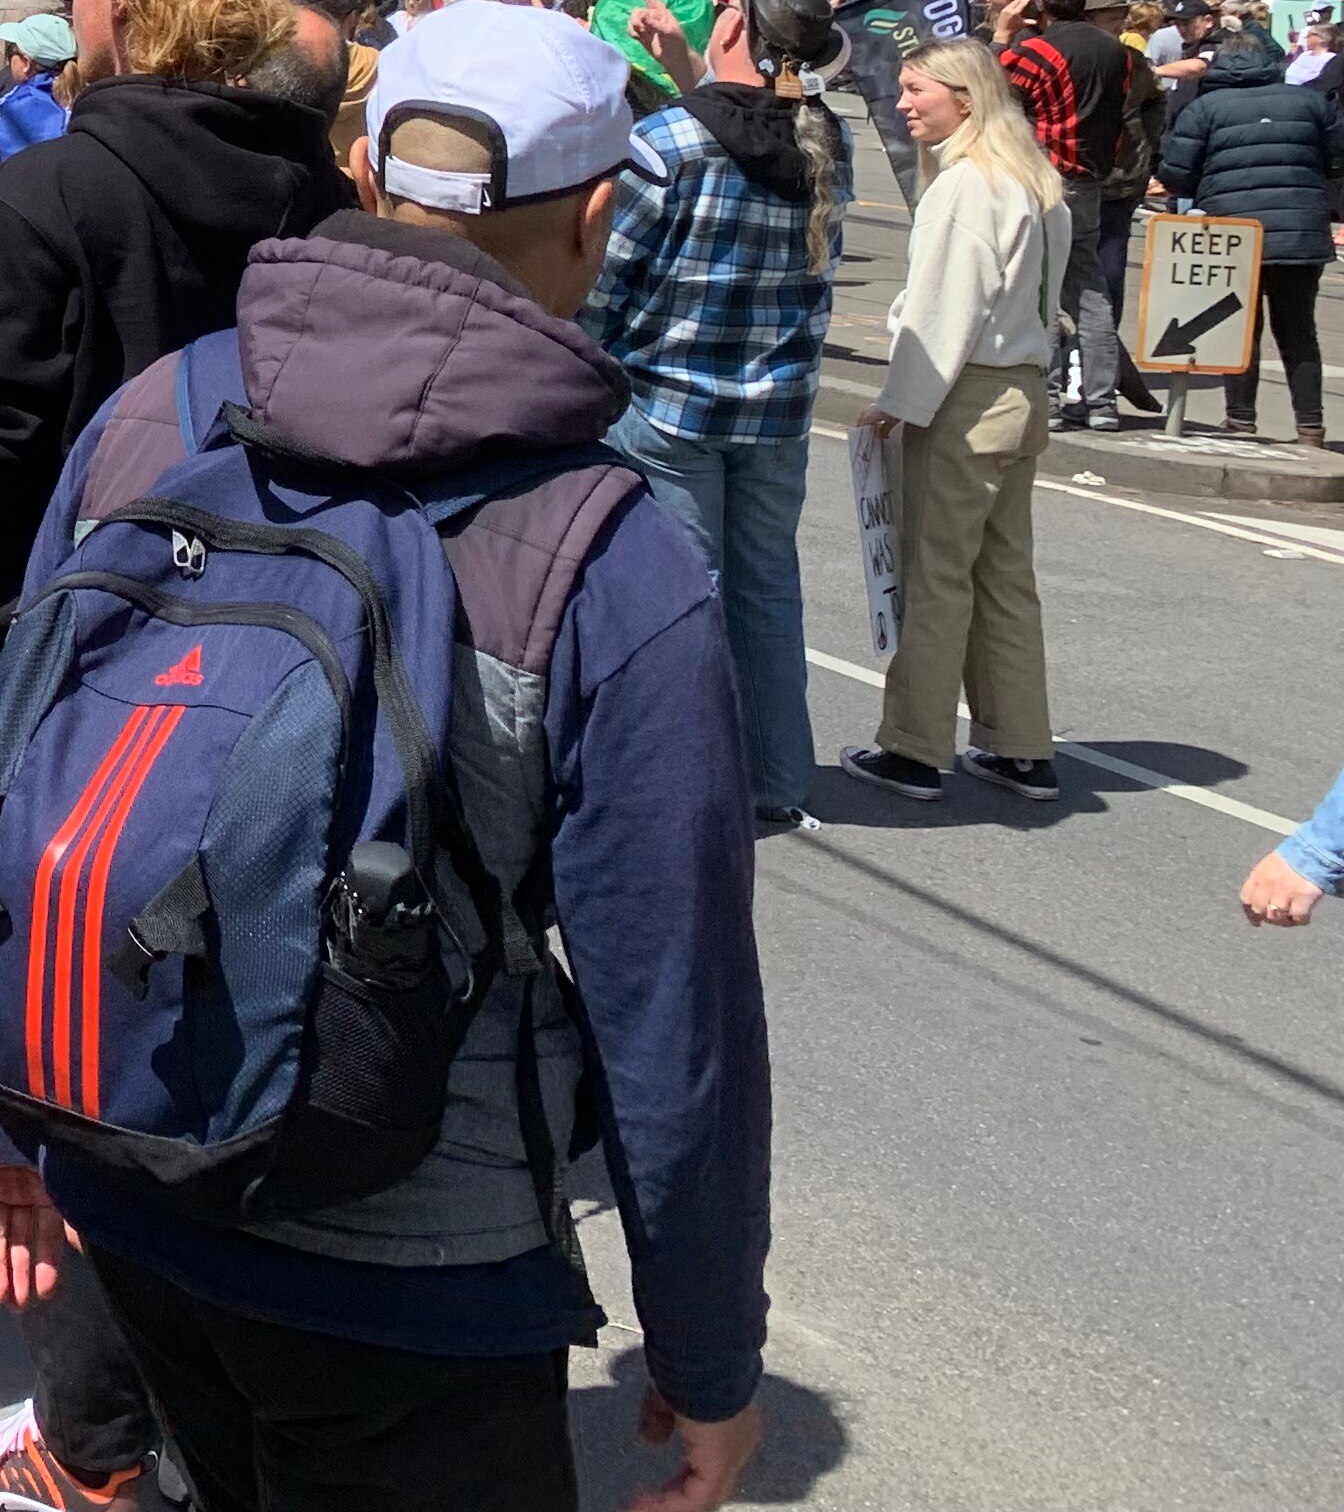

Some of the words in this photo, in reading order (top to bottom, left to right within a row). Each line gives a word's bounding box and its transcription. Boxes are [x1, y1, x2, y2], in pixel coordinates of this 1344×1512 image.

[893, 26, 920, 58] ST
[1171, 231, 1242, 256] KEEP
[1171, 263, 1237, 287] LEFT
[154, 672, 205, 687] adidas
